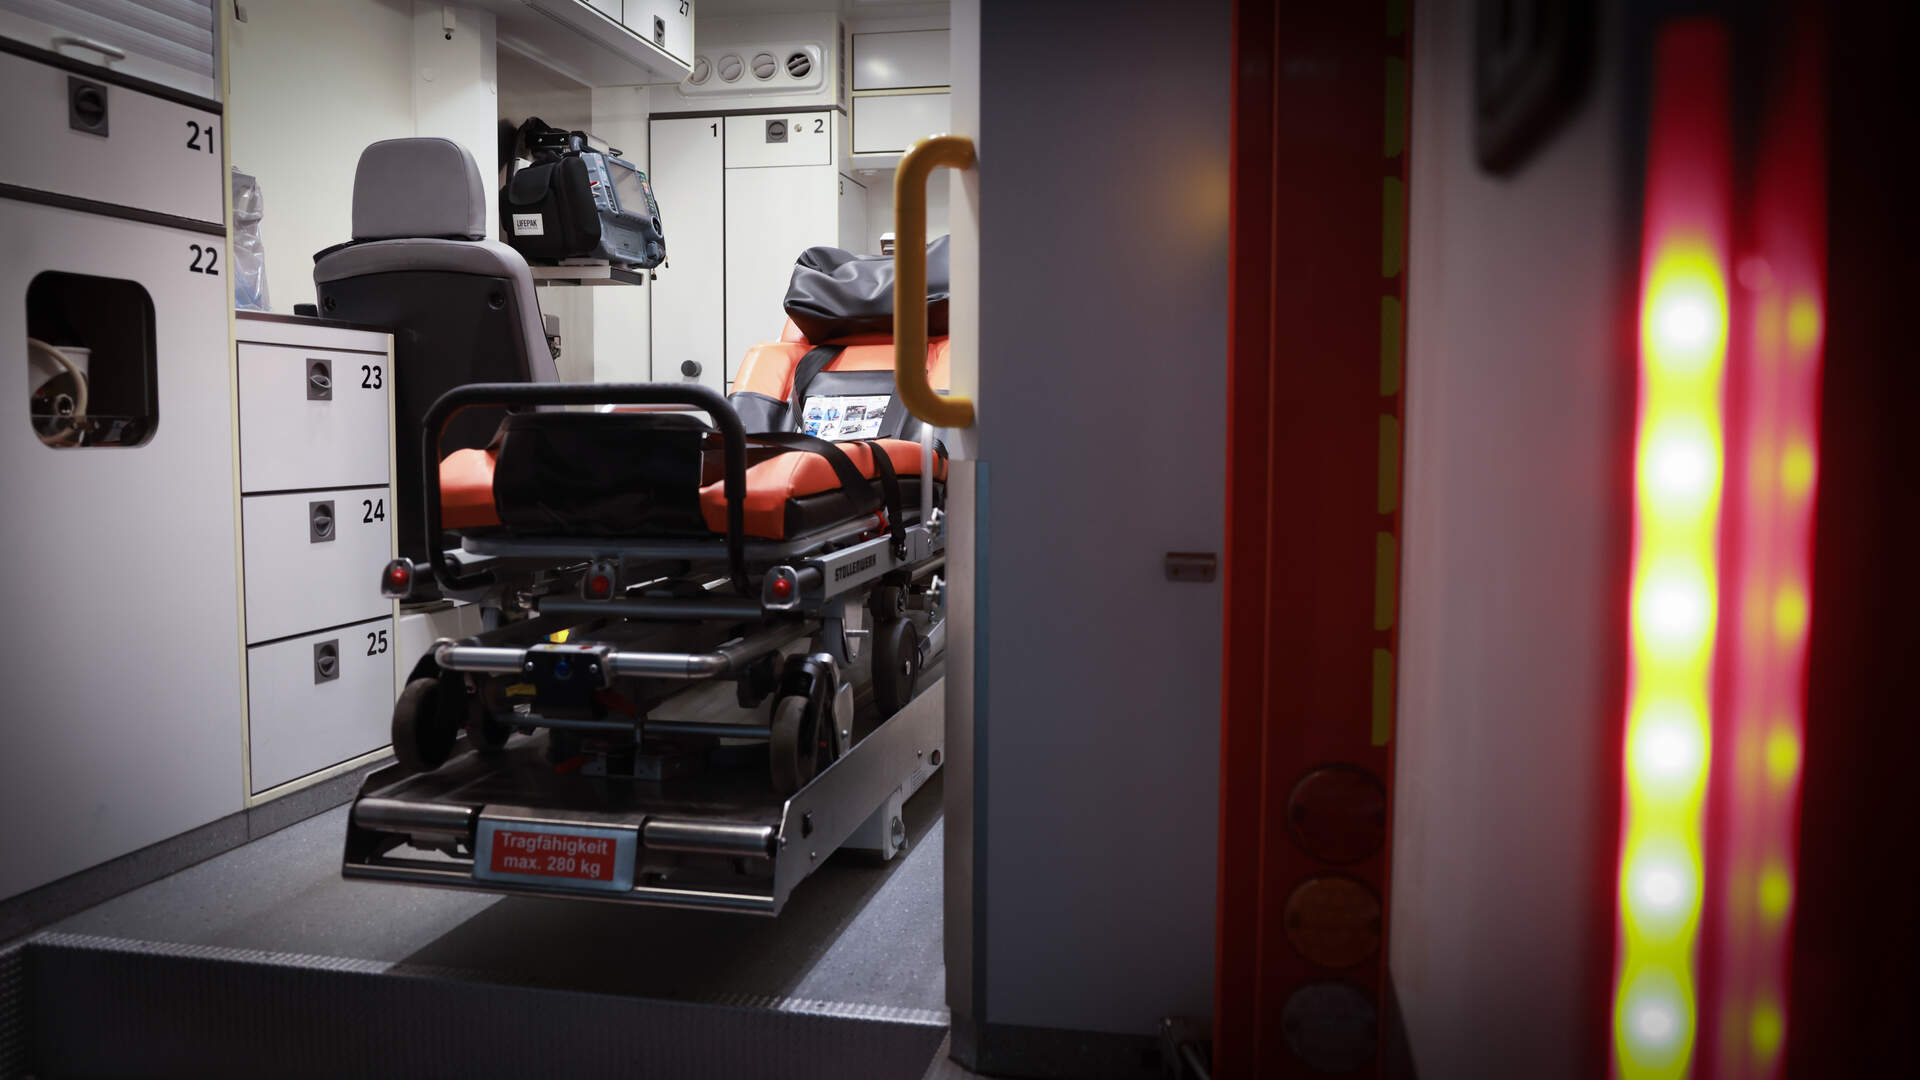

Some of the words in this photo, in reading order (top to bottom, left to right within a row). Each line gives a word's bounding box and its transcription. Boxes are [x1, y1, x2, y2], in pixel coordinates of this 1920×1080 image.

[680, 0, 690, 17] 27
[186, 120, 214, 154] 21
[710, 122, 717, 138] 1
[813, 118, 824, 134] 2
[516, 219, 538, 228] LIFEPAK
[189, 243, 219, 276] 22
[361, 364, 383, 390] 23
[362, 498, 385, 524] 24
[834, 554, 876, 582] STOLLENWERK
[366, 629, 388, 657] 25
[501, 832, 608, 855] Tragfähigkeit
[503, 856, 542, 870] max.
[547, 855, 576, 873] 280
[580, 859, 601, 877] kg
